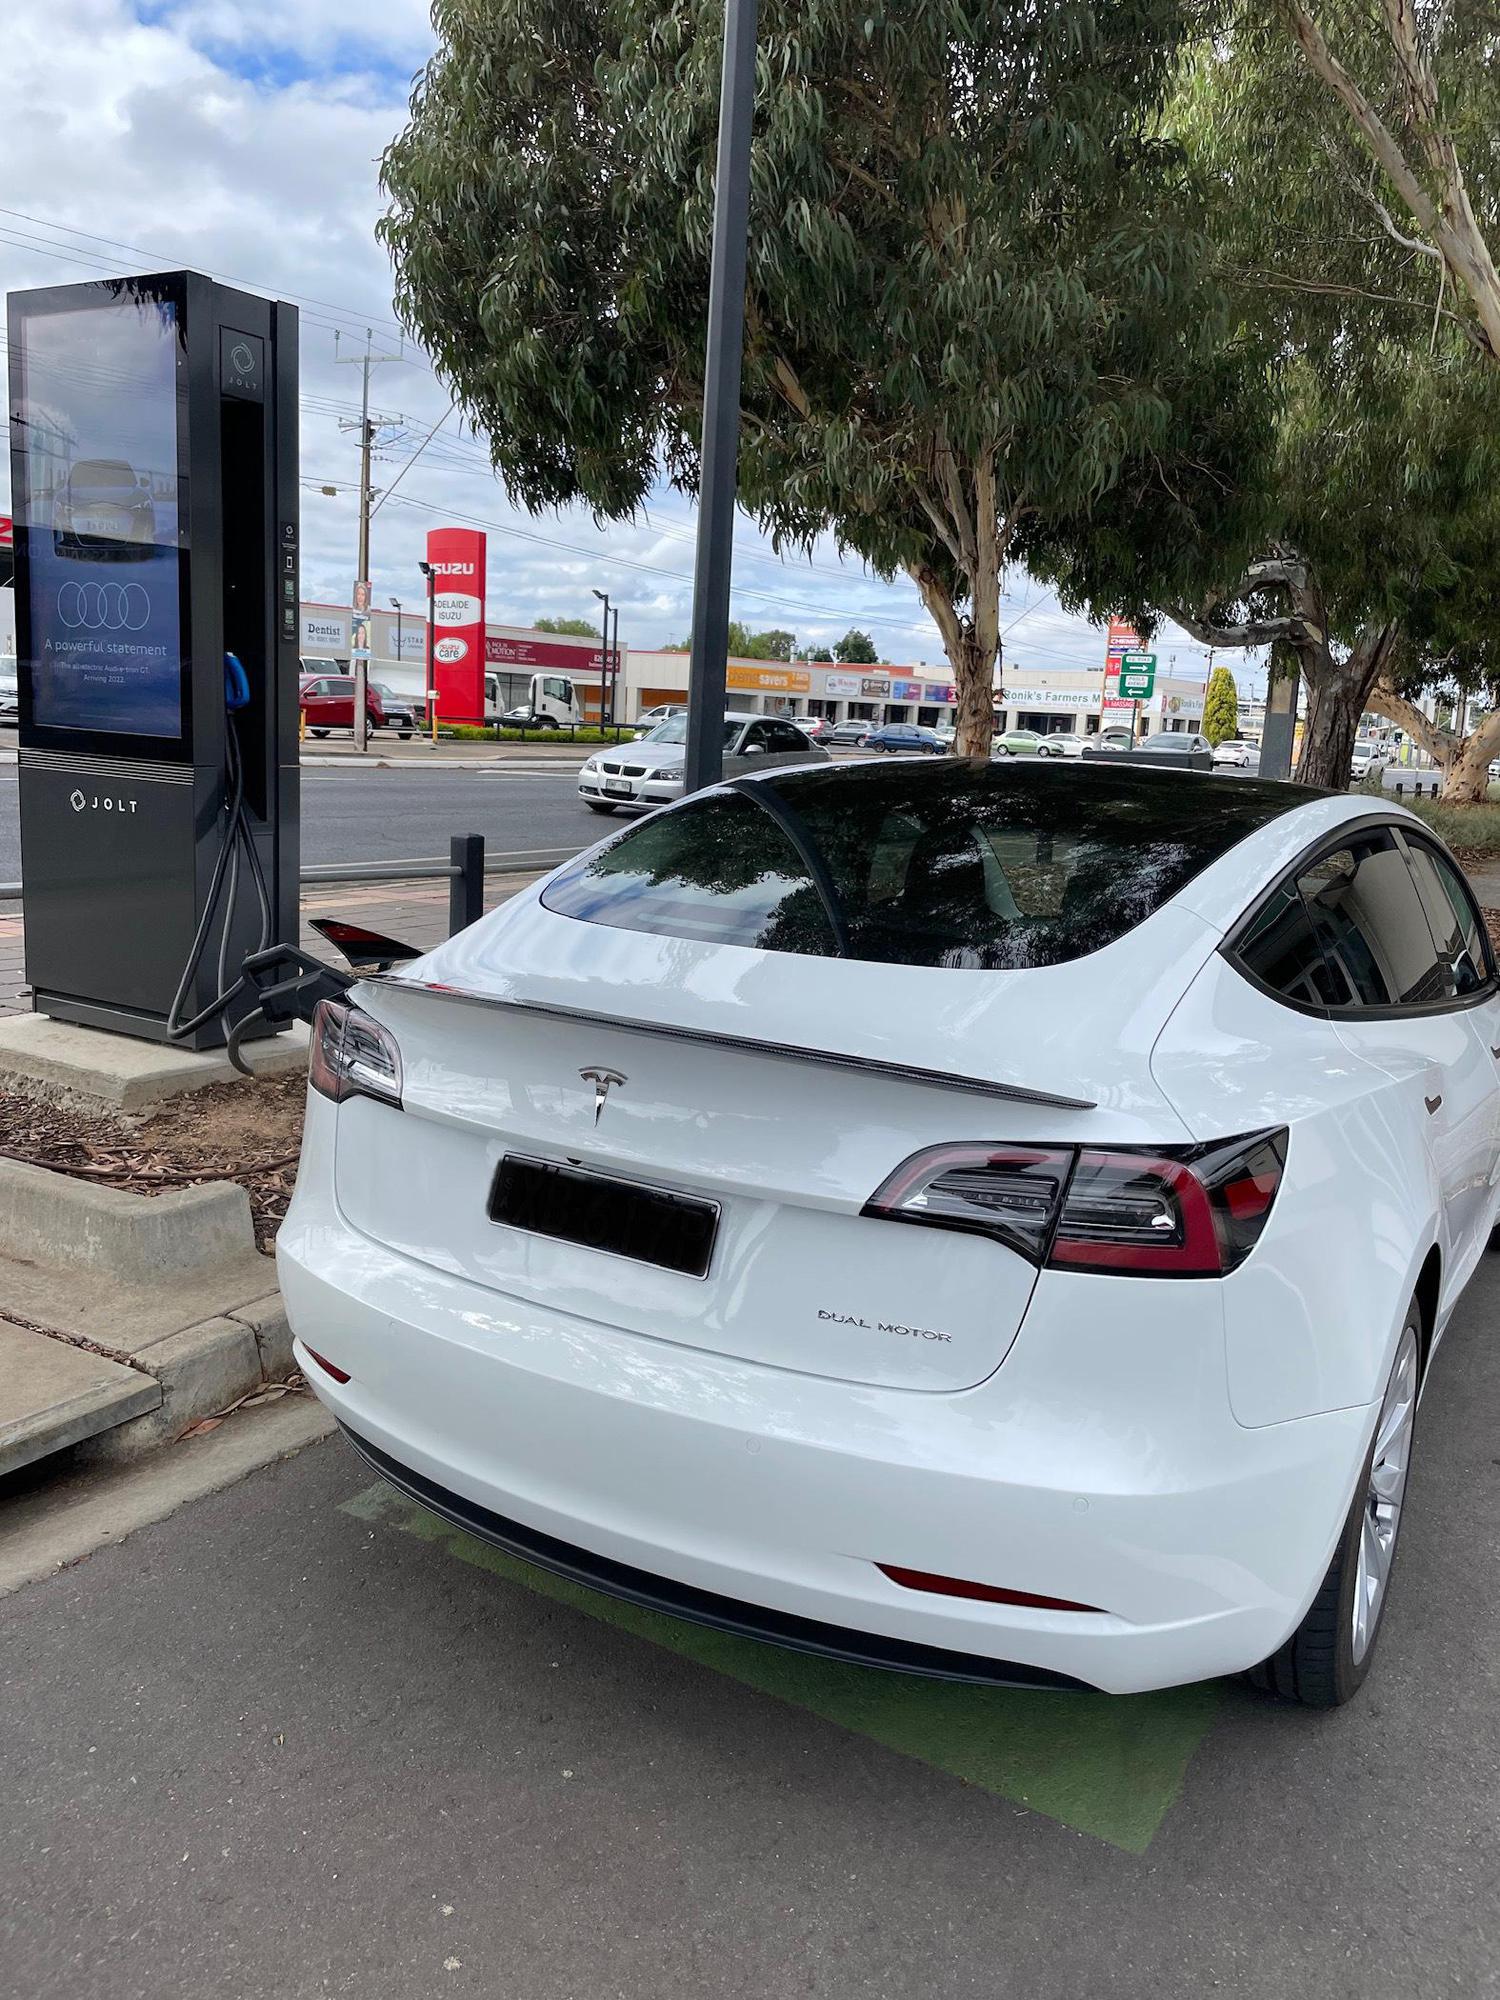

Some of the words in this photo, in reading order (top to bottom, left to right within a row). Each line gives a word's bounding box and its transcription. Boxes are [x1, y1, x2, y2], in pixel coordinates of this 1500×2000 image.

[229, 377, 257, 390] JOLT
[434, 600, 470, 609] ADELAIDE
[438, 611, 462, 620] ISUZU
[308, 623, 340, 636] Dentist
[44, 638, 53, 650] A
[55, 640, 104, 653] powerful
[107, 643, 167, 656] statement
[439, 649, 460, 658] care
[1004, 690, 1042, 701] Ronik's
[1045, 692, 1089, 703] Farmers
[92, 796, 138, 814] JOLT
[818, 1309, 871, 1328] DUAL
[878, 1321, 952, 1343] MOTOR
